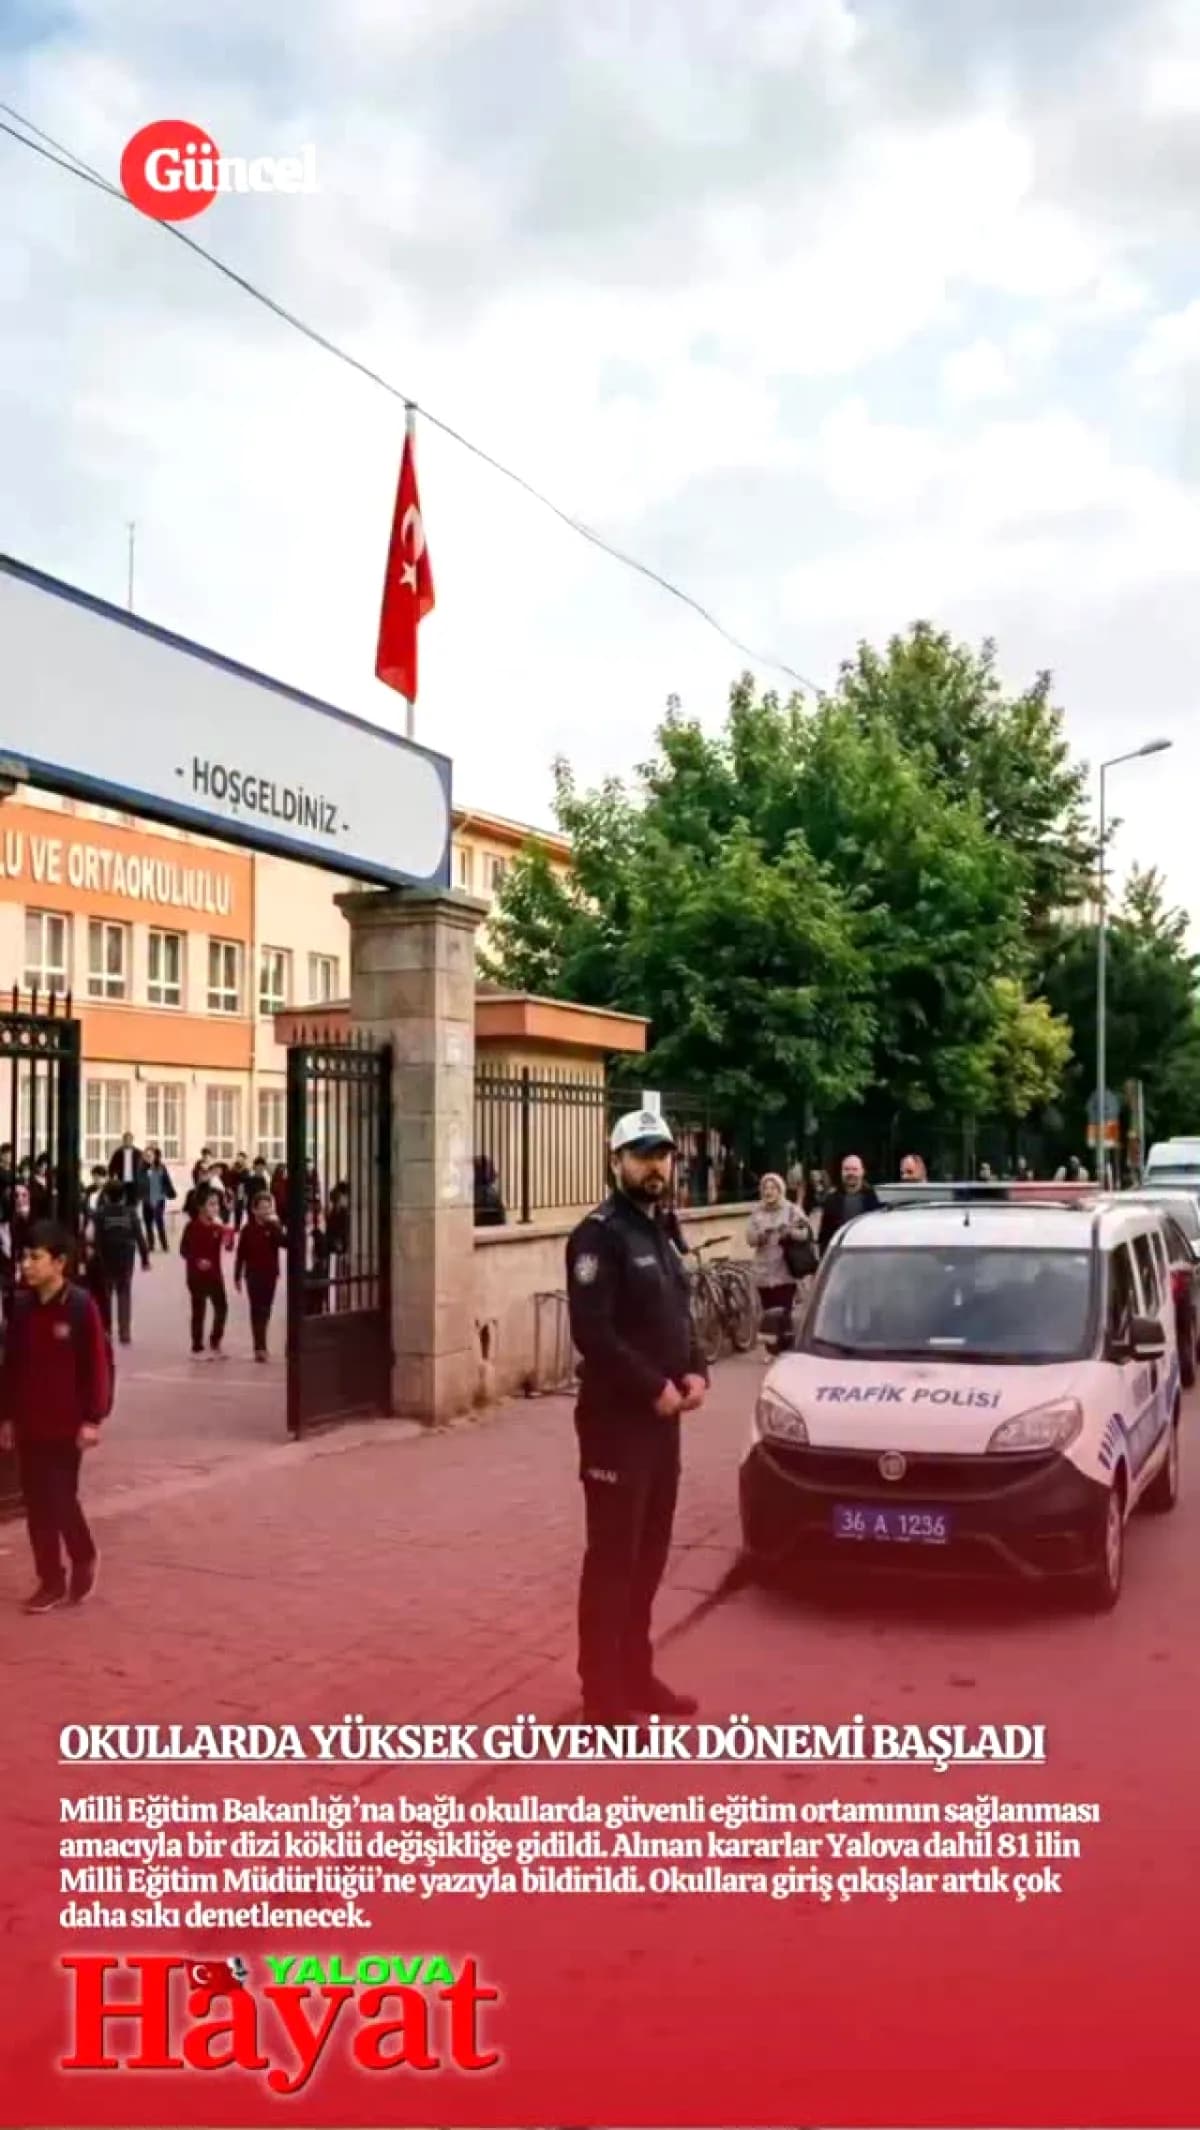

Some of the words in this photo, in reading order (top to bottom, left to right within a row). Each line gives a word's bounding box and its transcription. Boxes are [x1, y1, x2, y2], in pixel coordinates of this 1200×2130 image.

[193, 755, 337, 834] HOŞGELDİNİZ
[0, 829, 22, 875] U
[29, 834, 62, 882] VE
[815, 1384, 904, 1403] TRAFİK
[911, 1387, 1002, 1409] POLİSİ
[841, 1511, 866, 1533] 36
[873, 1514, 888, 1534] A
